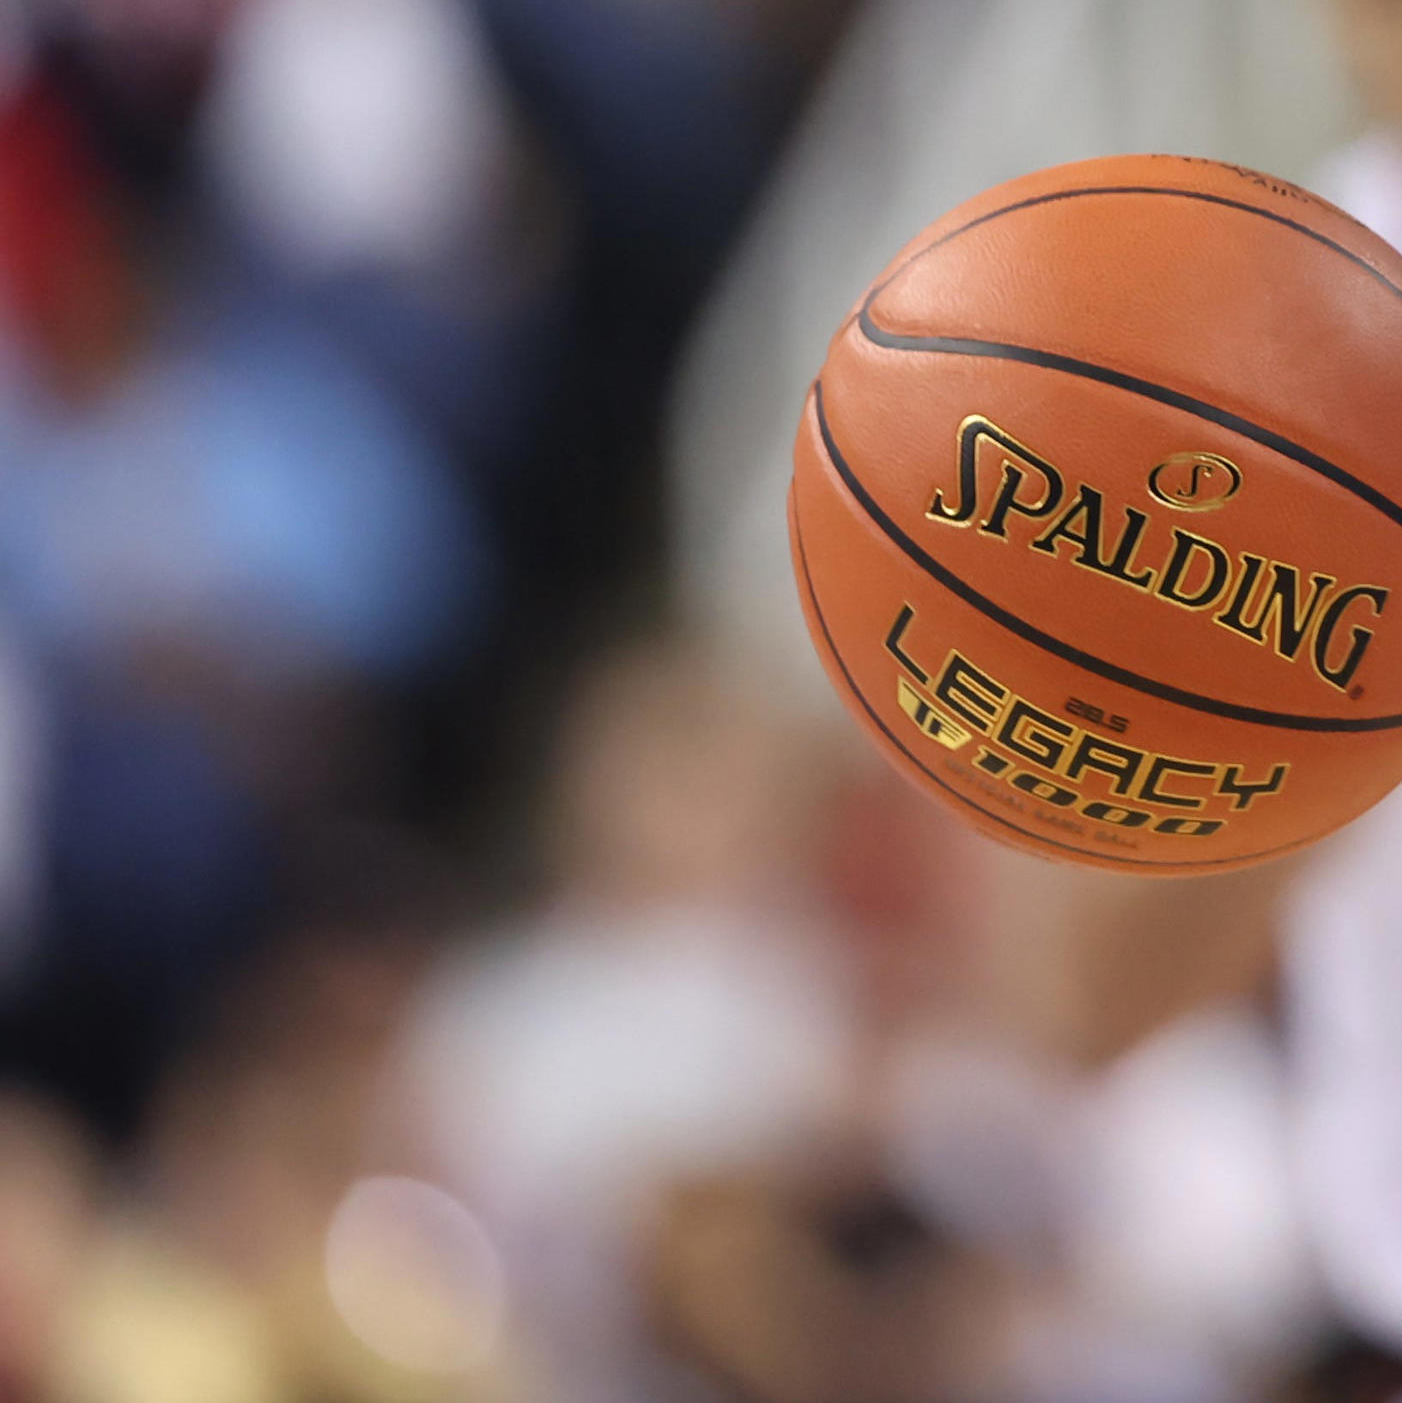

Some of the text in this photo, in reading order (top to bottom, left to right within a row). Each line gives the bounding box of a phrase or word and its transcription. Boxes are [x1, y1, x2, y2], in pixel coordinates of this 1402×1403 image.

[925, 413, 1389, 699] SPALDING
[881, 600, 1289, 811] LEGACY
[971, 744, 1228, 837] 1000
